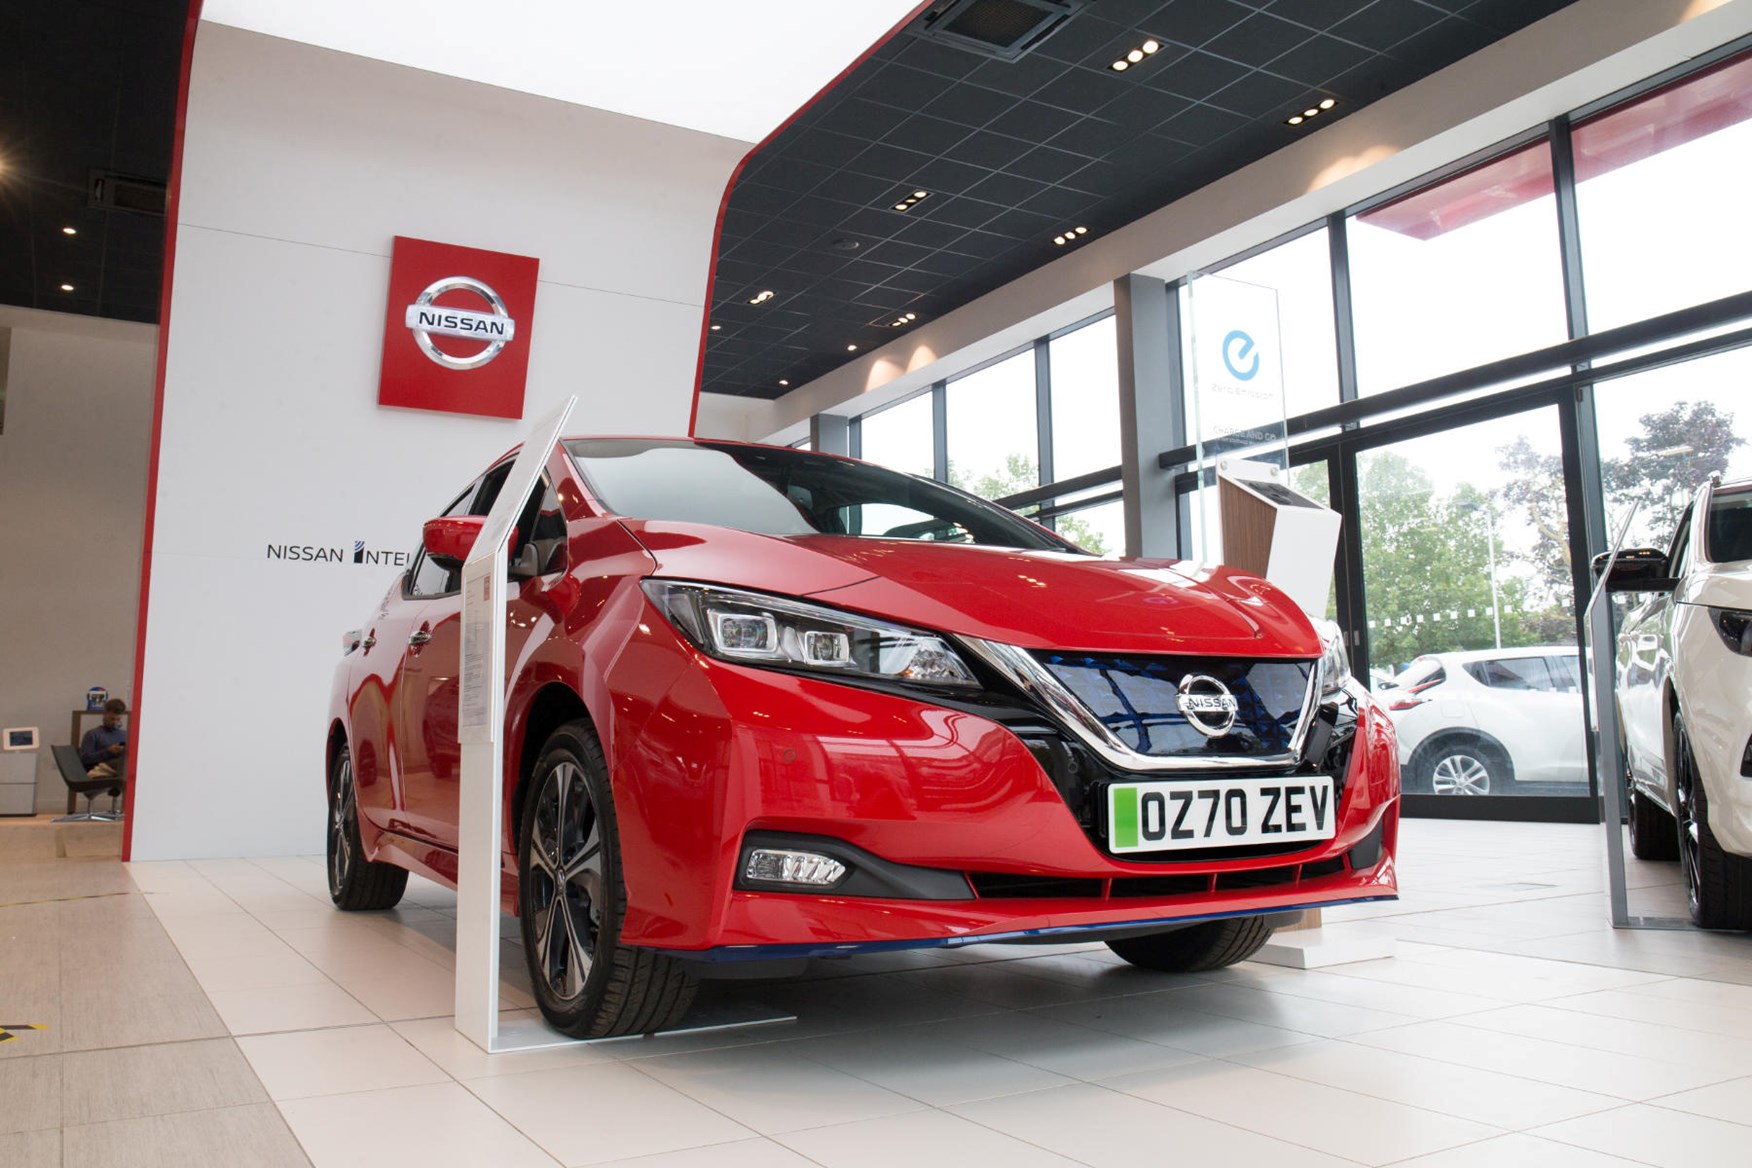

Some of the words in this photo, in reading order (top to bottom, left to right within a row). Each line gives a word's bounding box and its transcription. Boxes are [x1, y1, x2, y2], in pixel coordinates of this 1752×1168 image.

[419, 311, 505, 335] NISSAN
[1246, 430, 1264, 440] AND
[267, 544, 344, 563] NISSAN
[1188, 697, 1237, 709] NISSAN
[1141, 788, 1248, 841] OZ70
[1260, 785, 1329, 834] ZEV
